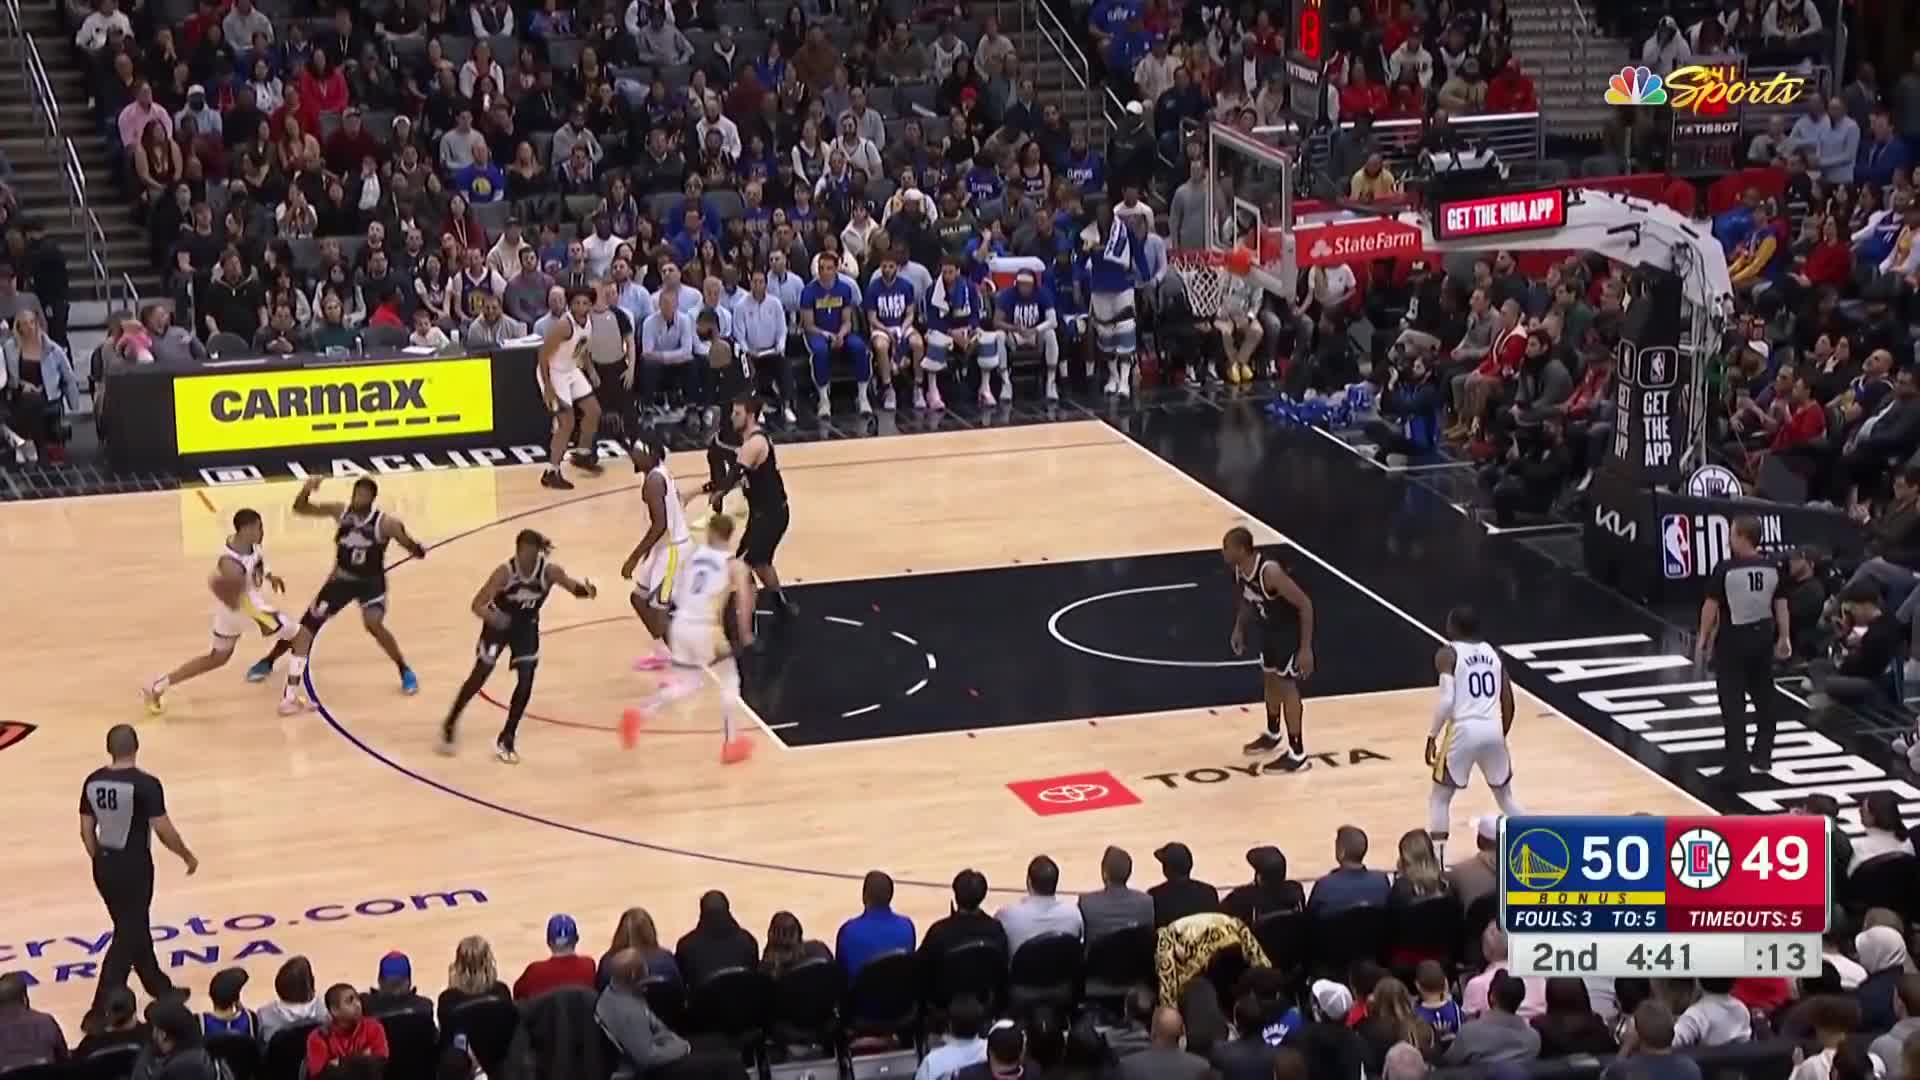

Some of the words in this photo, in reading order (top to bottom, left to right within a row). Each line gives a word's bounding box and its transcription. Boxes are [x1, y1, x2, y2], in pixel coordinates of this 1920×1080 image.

[1447, 208, 1471, 230] GET
[1474, 205, 1499, 227] THE
[1500, 202, 1527, 224] NBA
[1529, 198, 1555, 221] APP
[1643, 390, 1670, 415] GET
[1642, 416, 1671, 440] THE
[1644, 441, 1672, 466] APP
[1747, 571, 1764, 592] 18
[1468, 670, 1496, 698] 00
[1143, 748, 1392, 789] TOYTA
[96, 787, 118, 811] 28
